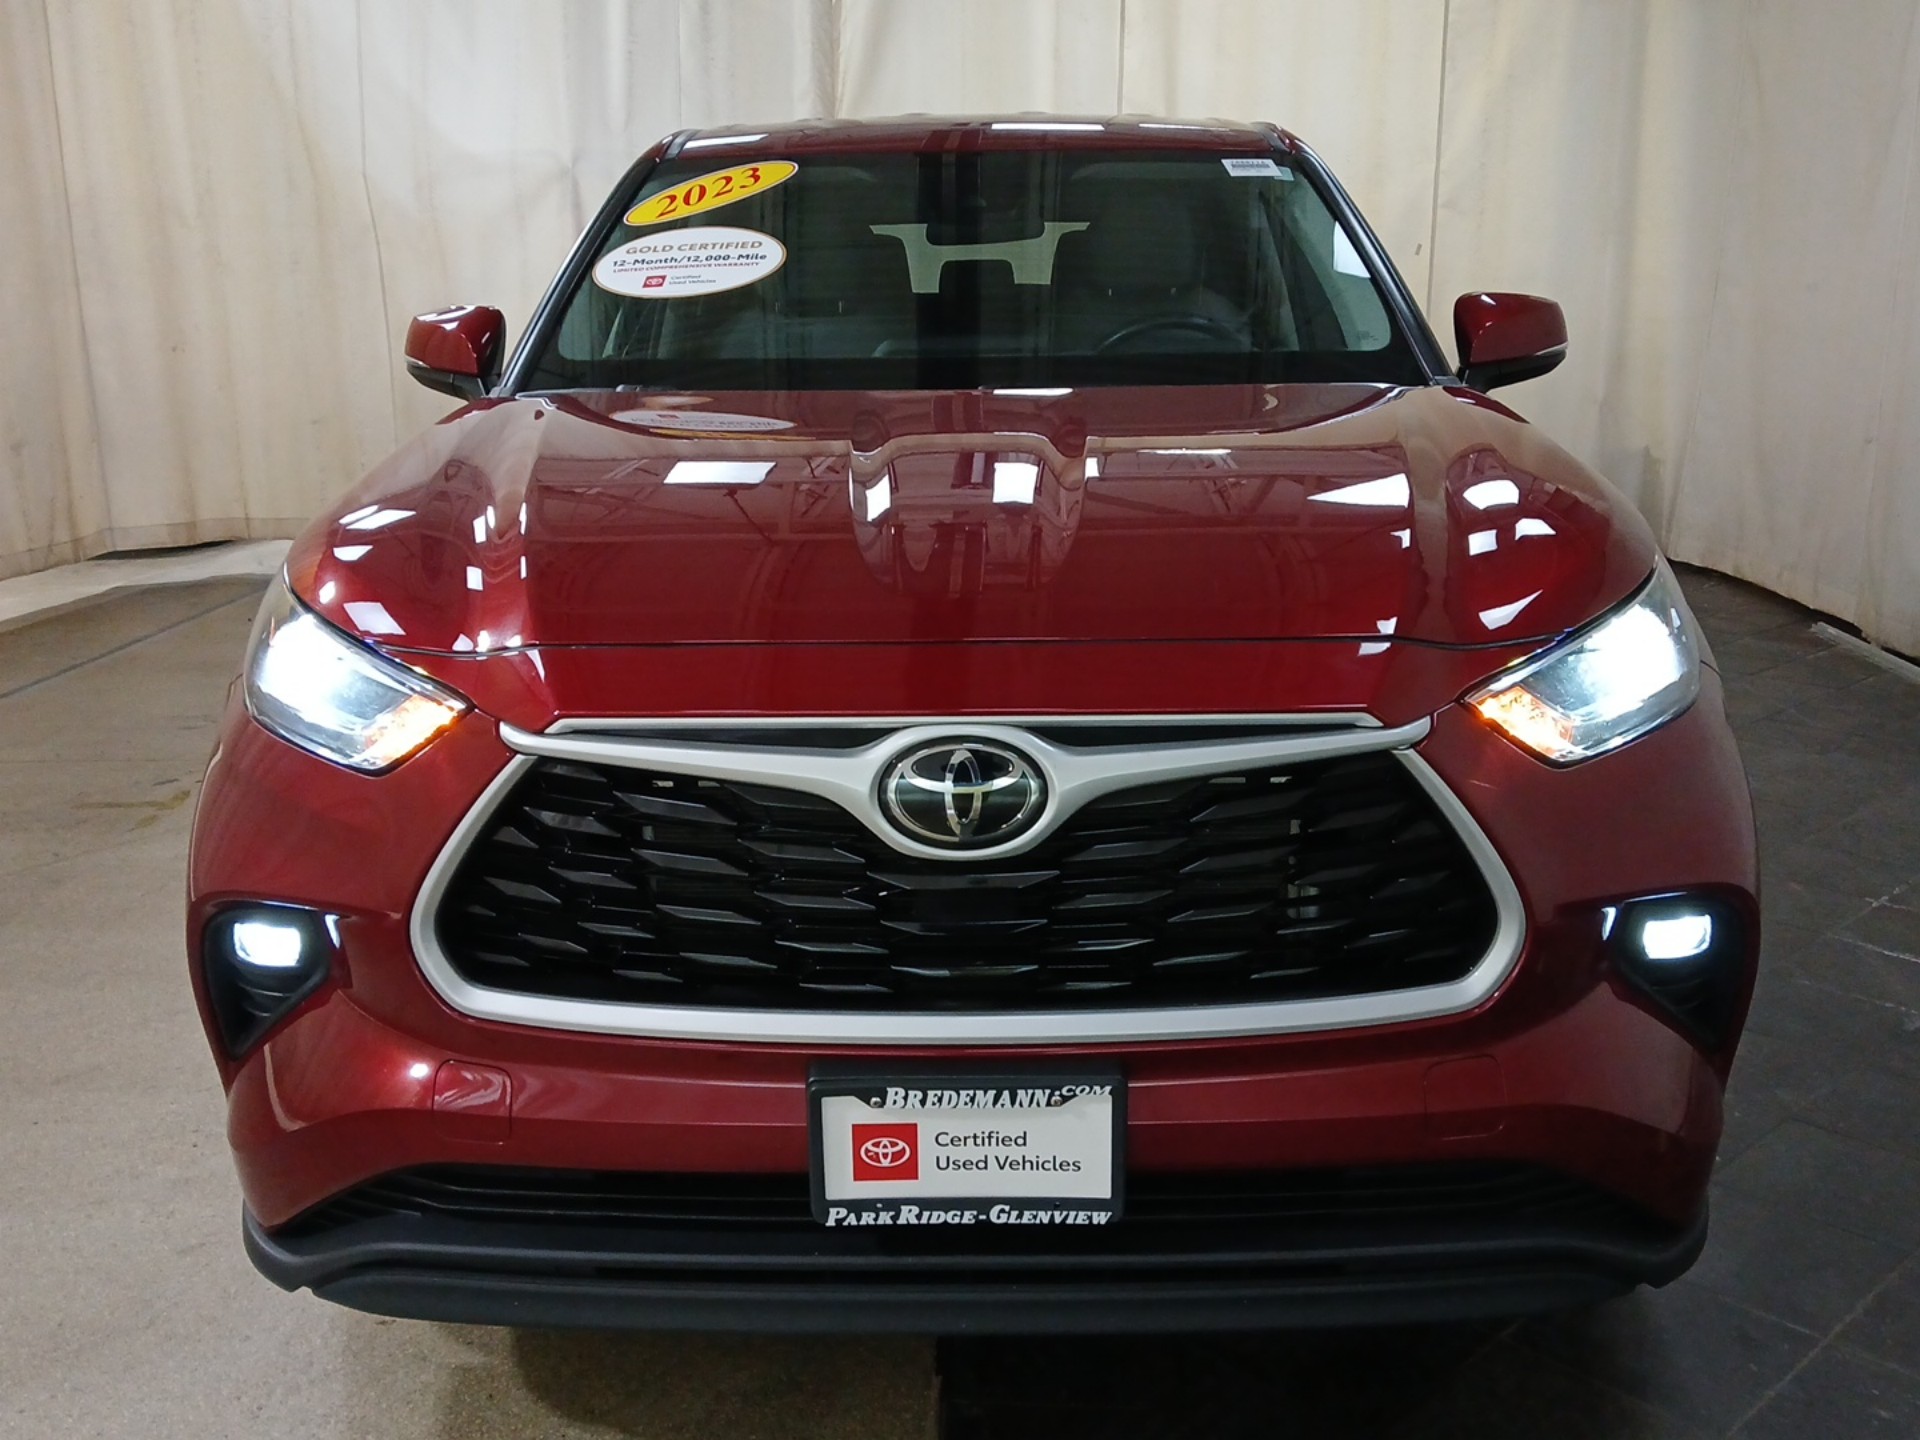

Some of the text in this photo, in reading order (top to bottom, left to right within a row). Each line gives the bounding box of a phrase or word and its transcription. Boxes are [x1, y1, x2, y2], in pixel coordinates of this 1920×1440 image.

[656, 167, 762, 219] 2023
[625, 240, 763, 255] GOLD CERTIFIED
[613, 253, 768, 268] 12-Month/12,000-Mile
[714, 261, 760, 269] WARRANTY
[934, 1130, 1028, 1148] Certified
[935, 1155, 1082, 1173] Used Vehicles
